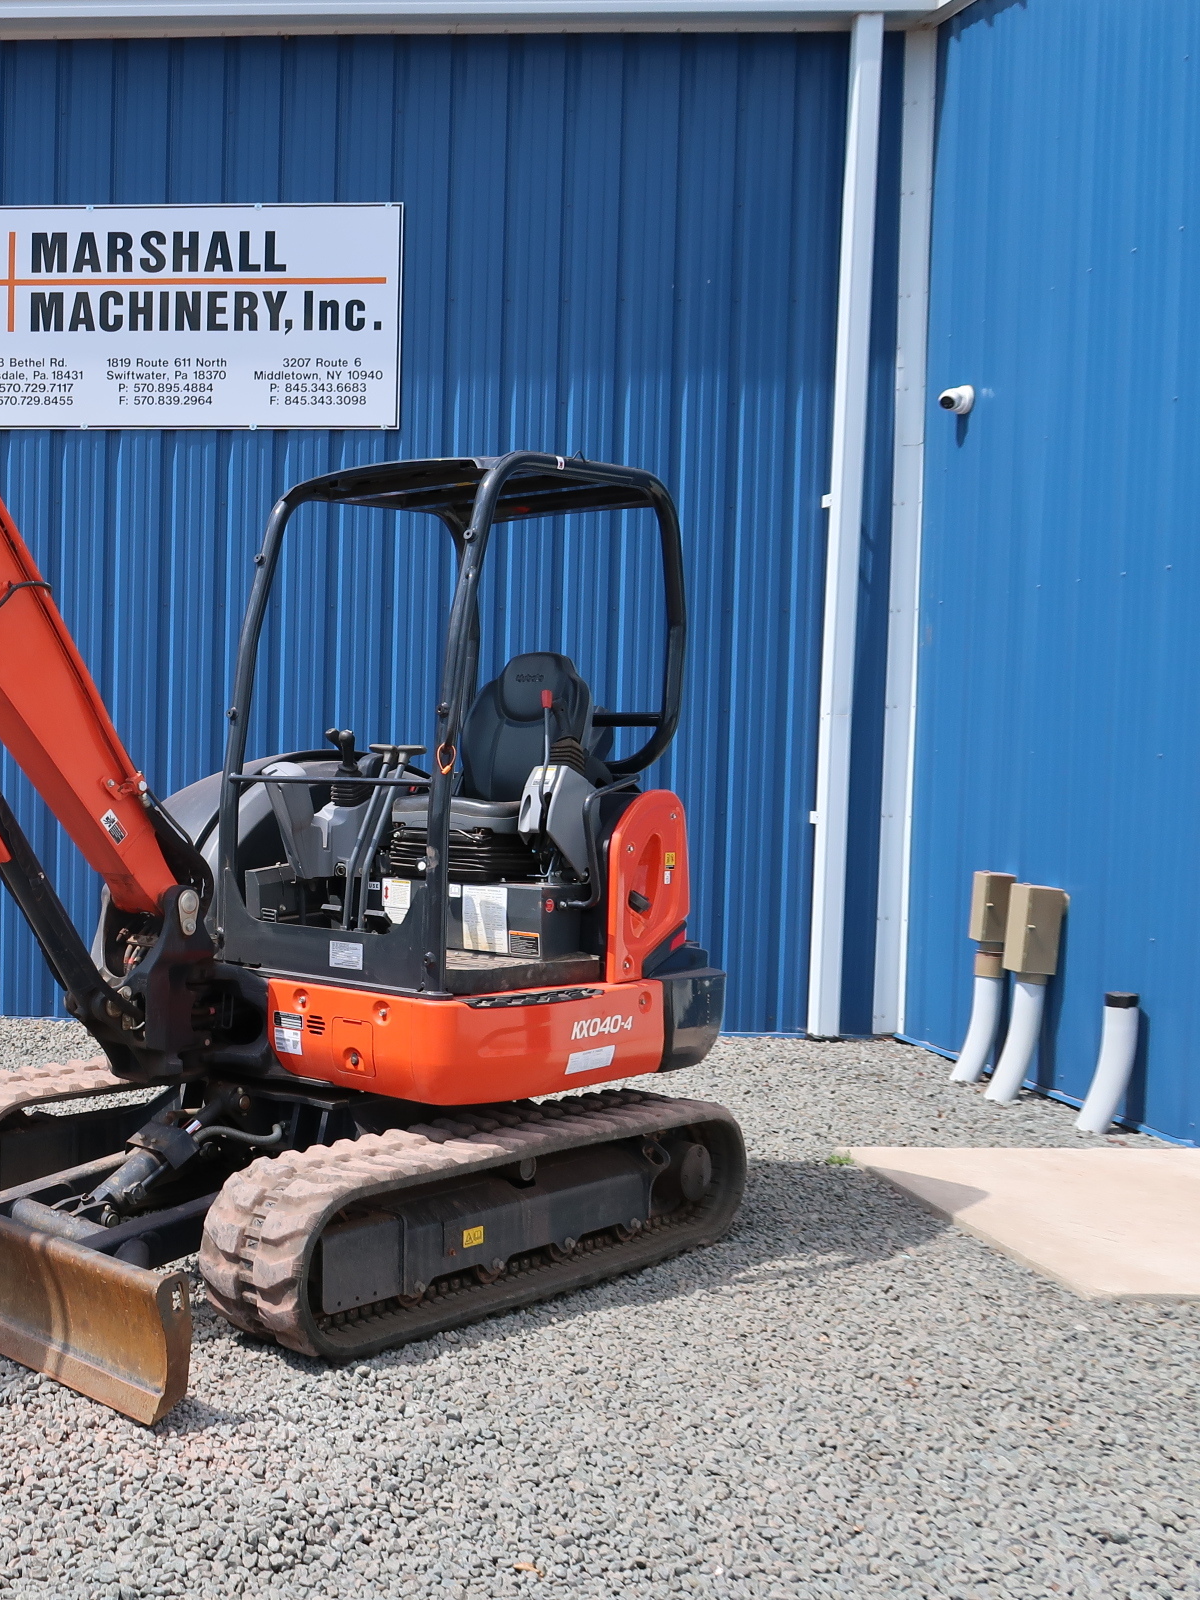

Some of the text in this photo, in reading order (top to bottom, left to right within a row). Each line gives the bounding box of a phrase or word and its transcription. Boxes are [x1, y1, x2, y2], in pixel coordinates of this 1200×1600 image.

[31, 231, 287, 273] MARSHALL
[10, 357, 45, 368] Bethel
[50, 357, 67, 368] Rd.
[106, 357, 227, 368] 1819 Route 611 North
[282, 357, 362, 368] 3207 Route 6
[33, 370, 49, 380] Pa.
[52, 370, 84, 380] 18431
[106, 370, 227, 381] Swiftwater, Pa 18370
[254, 370, 383, 381] Middletown, NY 10940
[0, 383, 74, 393] 570.729.7117
[118, 383, 213, 393] P: 570.895.4884
[270, 383, 367, 393] P: 845.343.6683
[119, 395, 213, 405] F: 570.839.2964
[269, 395, 367, 405] F: 845.343.3098
[571, 1015, 633, 1040] KX040-4
